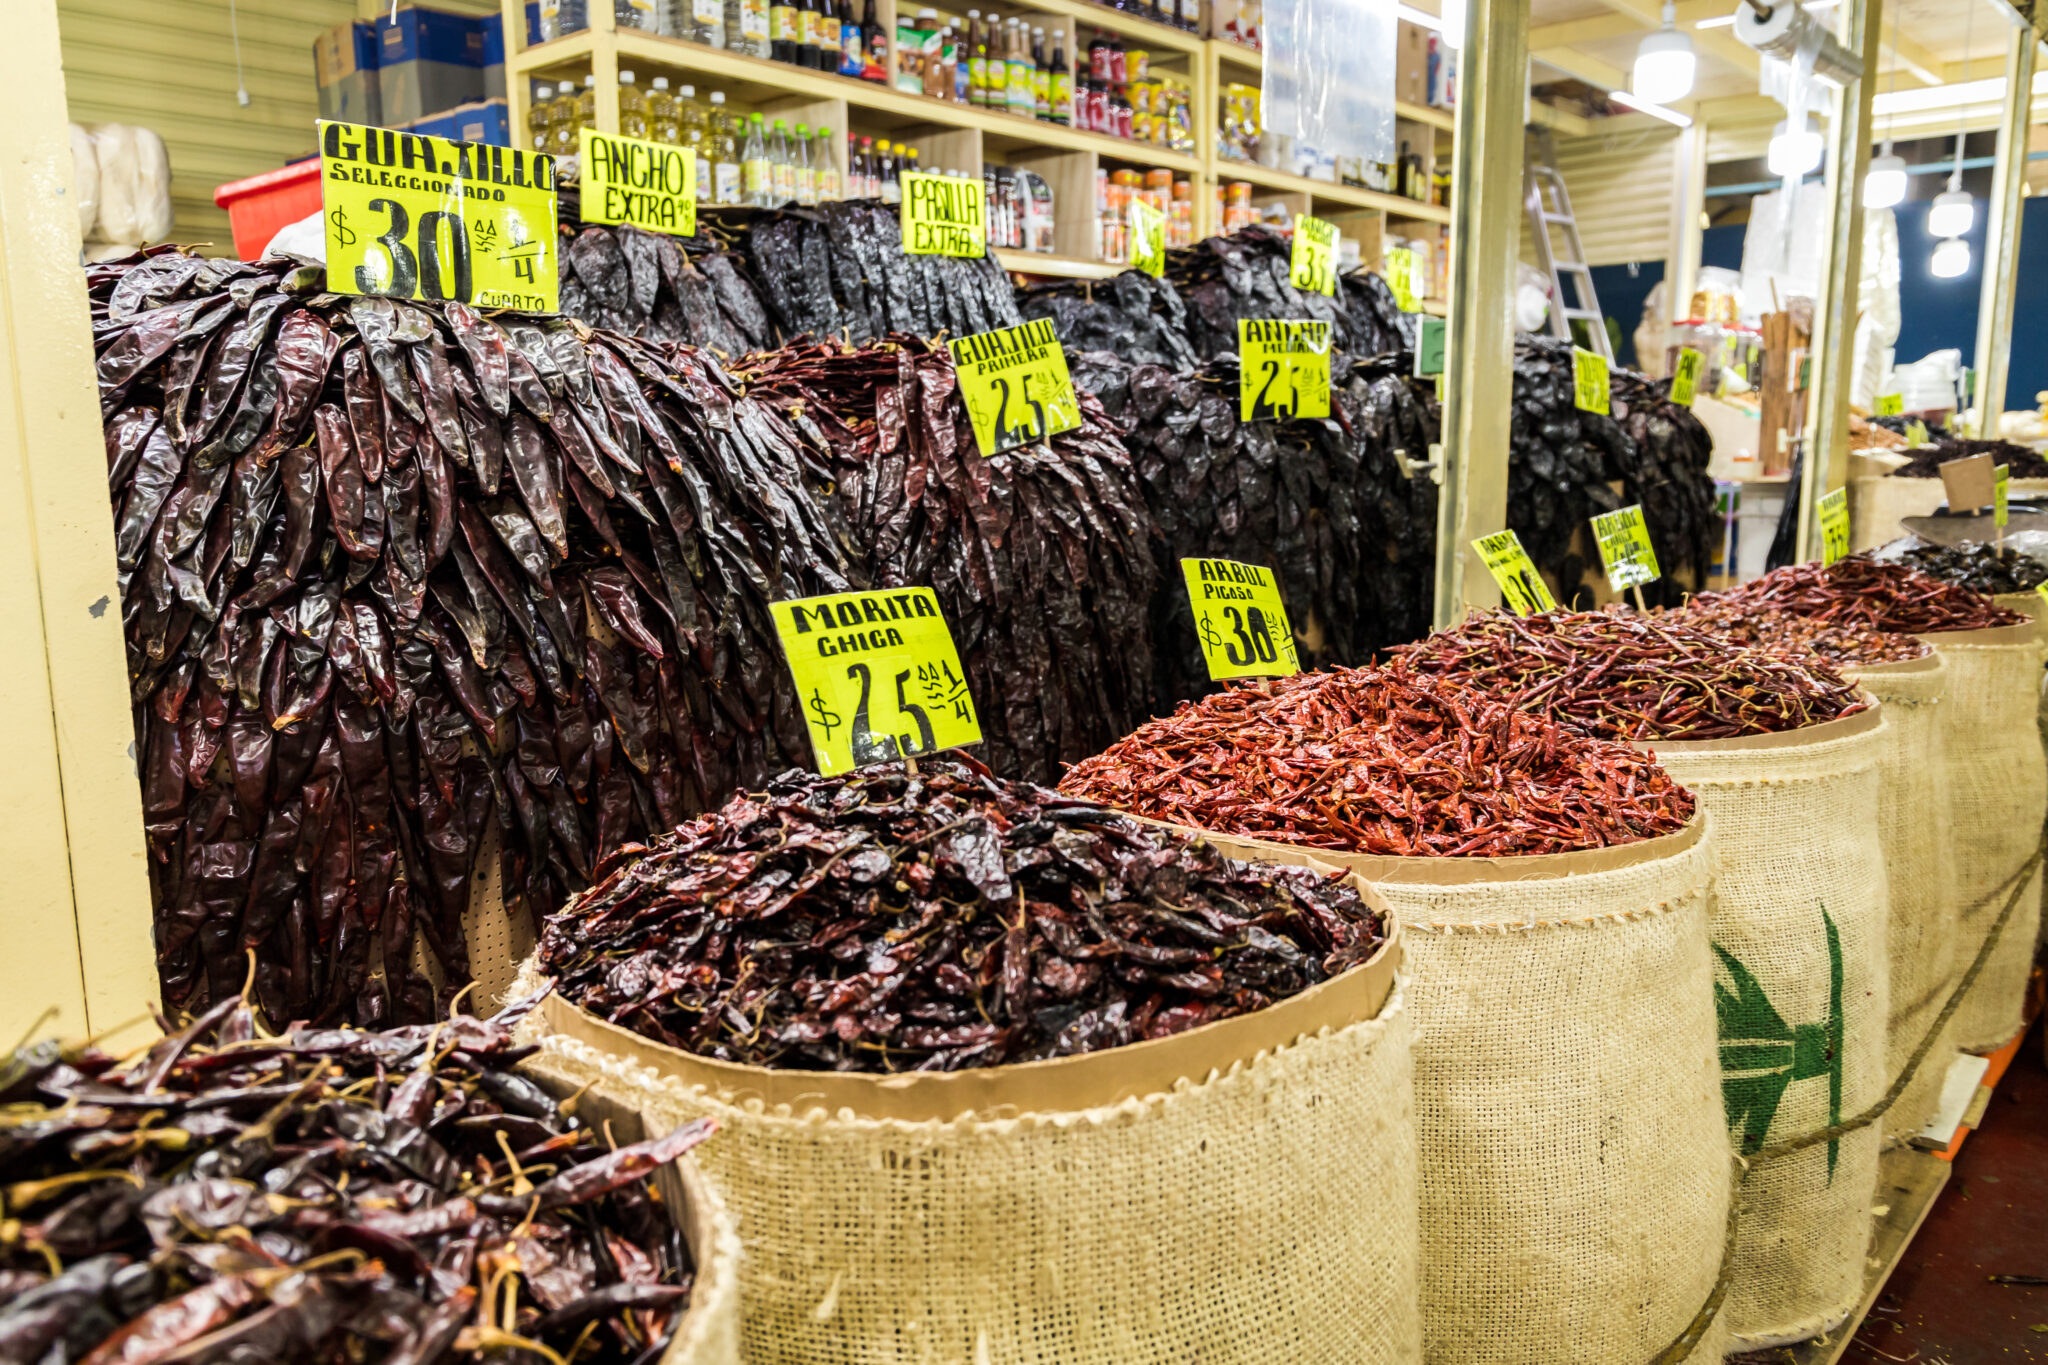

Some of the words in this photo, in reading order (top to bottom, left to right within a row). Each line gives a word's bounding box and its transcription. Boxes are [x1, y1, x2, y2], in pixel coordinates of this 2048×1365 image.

[324, 123, 557, 191] GUAJILLO
[591, 136, 685, 196] ANCHO
[605, 186, 676, 228] EXTRA
[909, 178, 978, 226] PASILLA
[915, 221, 970, 254] EXTRA
[480, 290, 545, 312] CUARTO
[977, 346, 1050, 376] PRIMERA
[1199, 560, 1267, 587] ARBOL
[1203, 583, 1254, 600] PICOSO
[790, 594, 938, 634] MORITA
